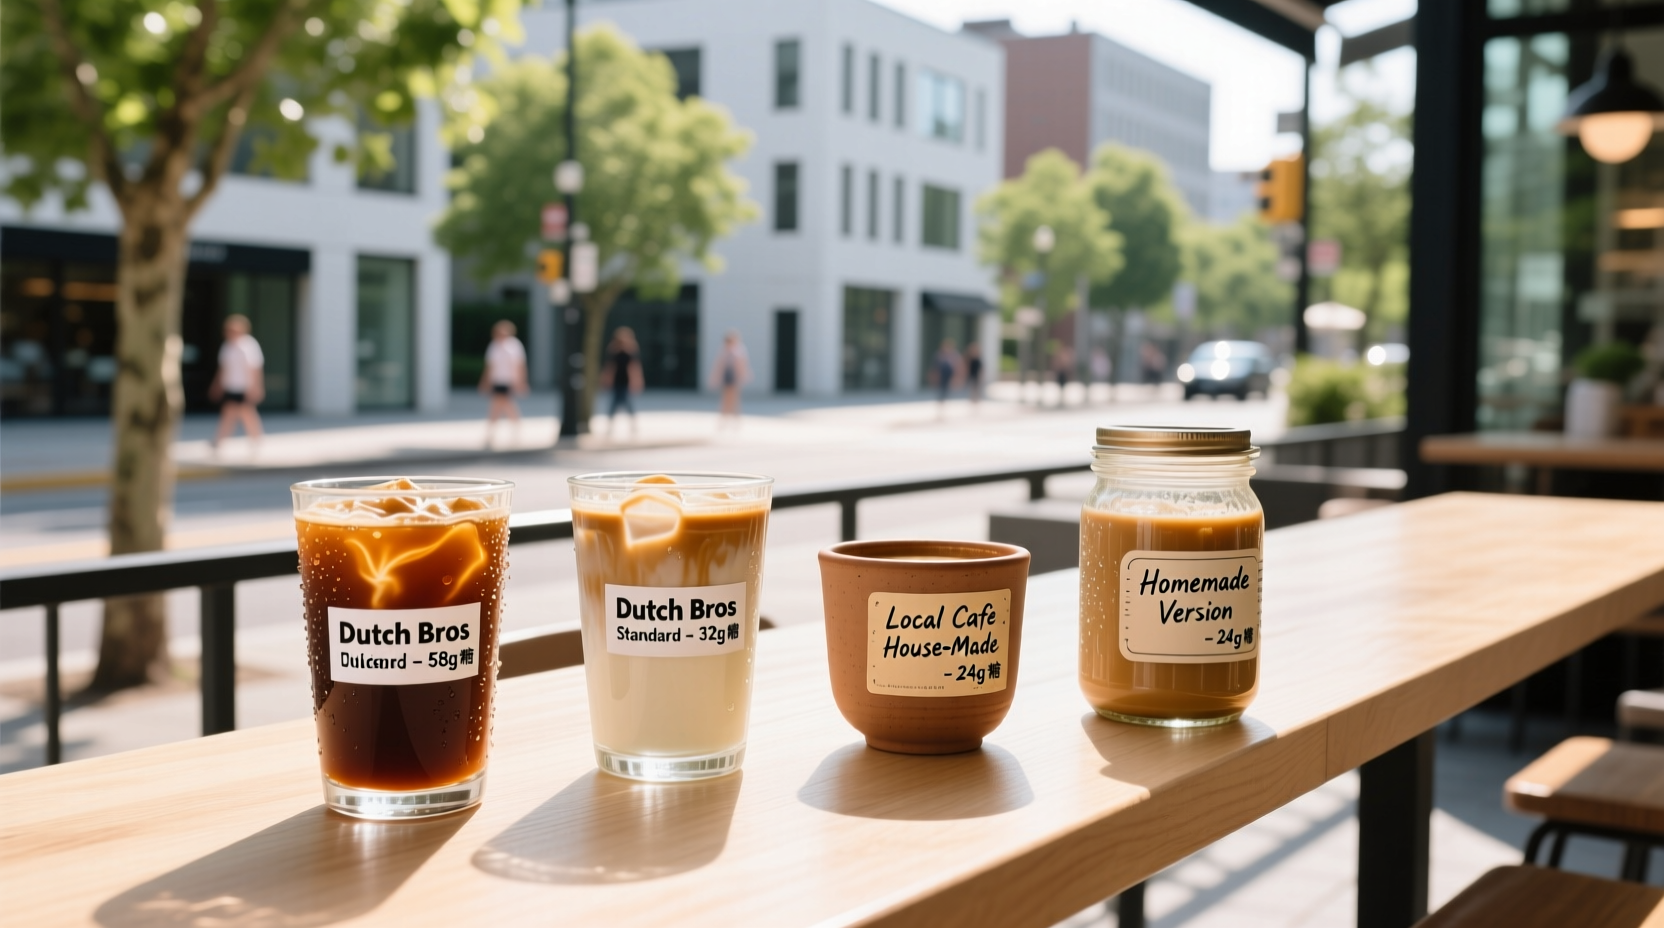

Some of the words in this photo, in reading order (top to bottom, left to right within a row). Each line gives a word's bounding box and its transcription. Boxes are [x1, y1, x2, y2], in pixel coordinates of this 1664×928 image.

[1140, 565, 1250, 596] Homemade
[616, 597, 683, 621] Dutch
[690, 598, 737, 620] Bros
[886, 605, 945, 630] Local
[952, 602, 996, 631] Cafe
[1160, 599, 1232, 625] Version
[339, 621, 411, 645] Dutch
[418, 622, 470, 644] Bros
[616, 625, 681, 642] Standard
[883, 631, 999, 659] House-Made
